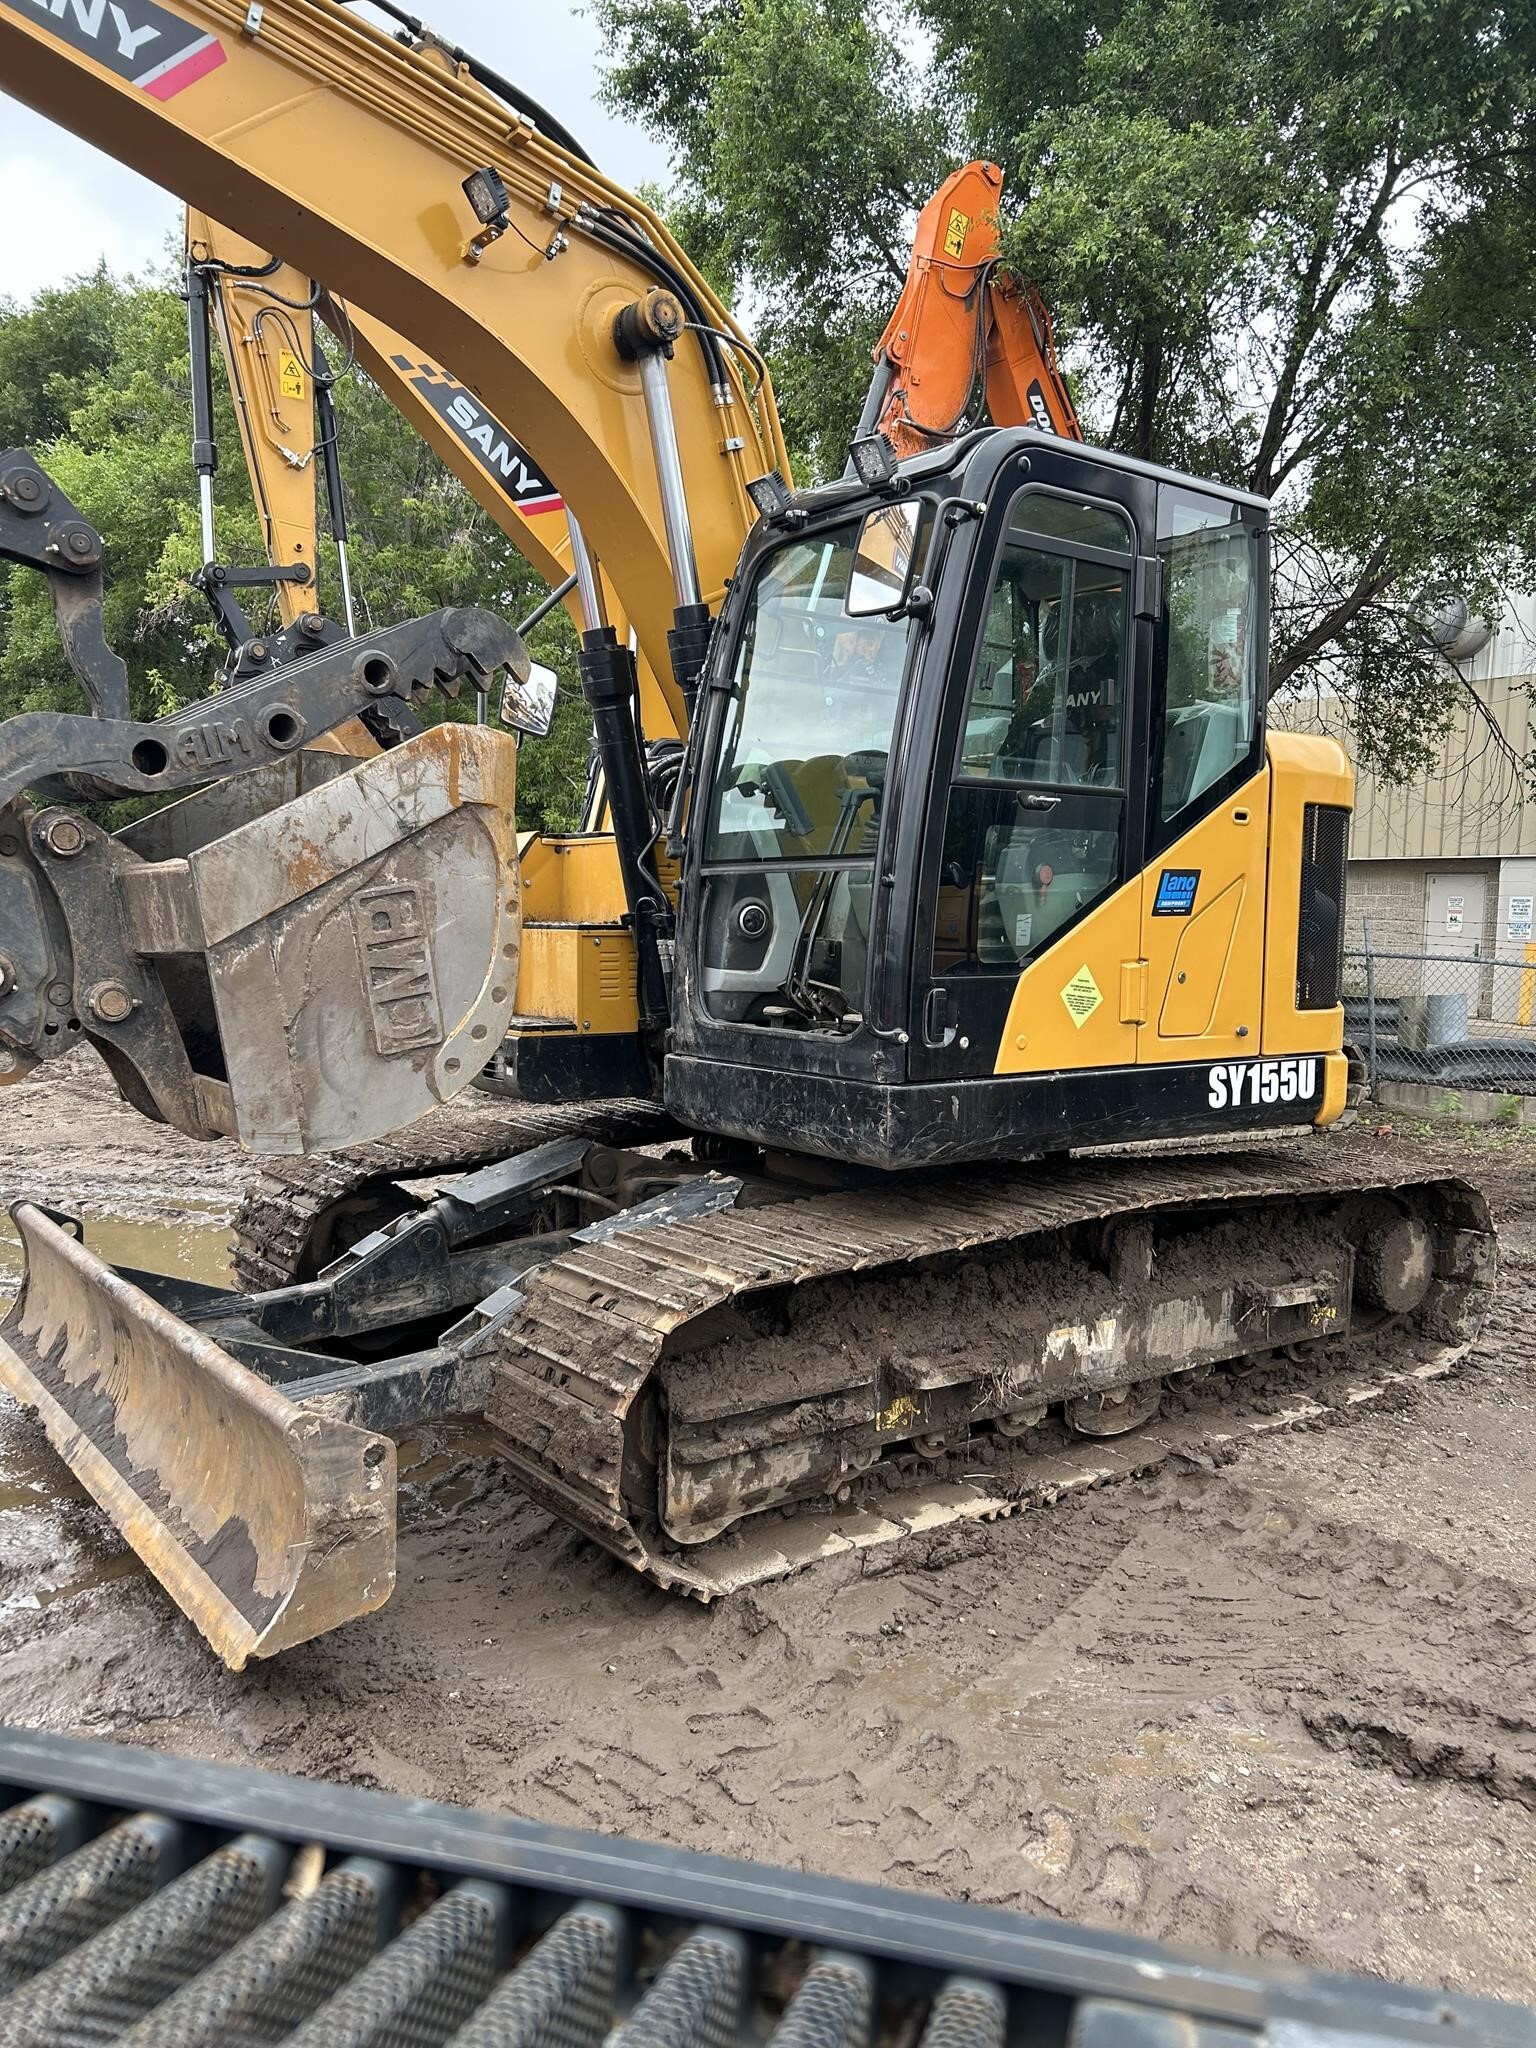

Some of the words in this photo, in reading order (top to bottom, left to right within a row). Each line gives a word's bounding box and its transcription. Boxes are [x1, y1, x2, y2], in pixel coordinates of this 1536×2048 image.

[32, 0, 161, 60] NY
[446, 396, 542, 494] SANY
[176, 717, 252, 767] AIM
[1159, 872, 1196, 899] Lano
[1208, 1059, 1316, 1109] SY155U
